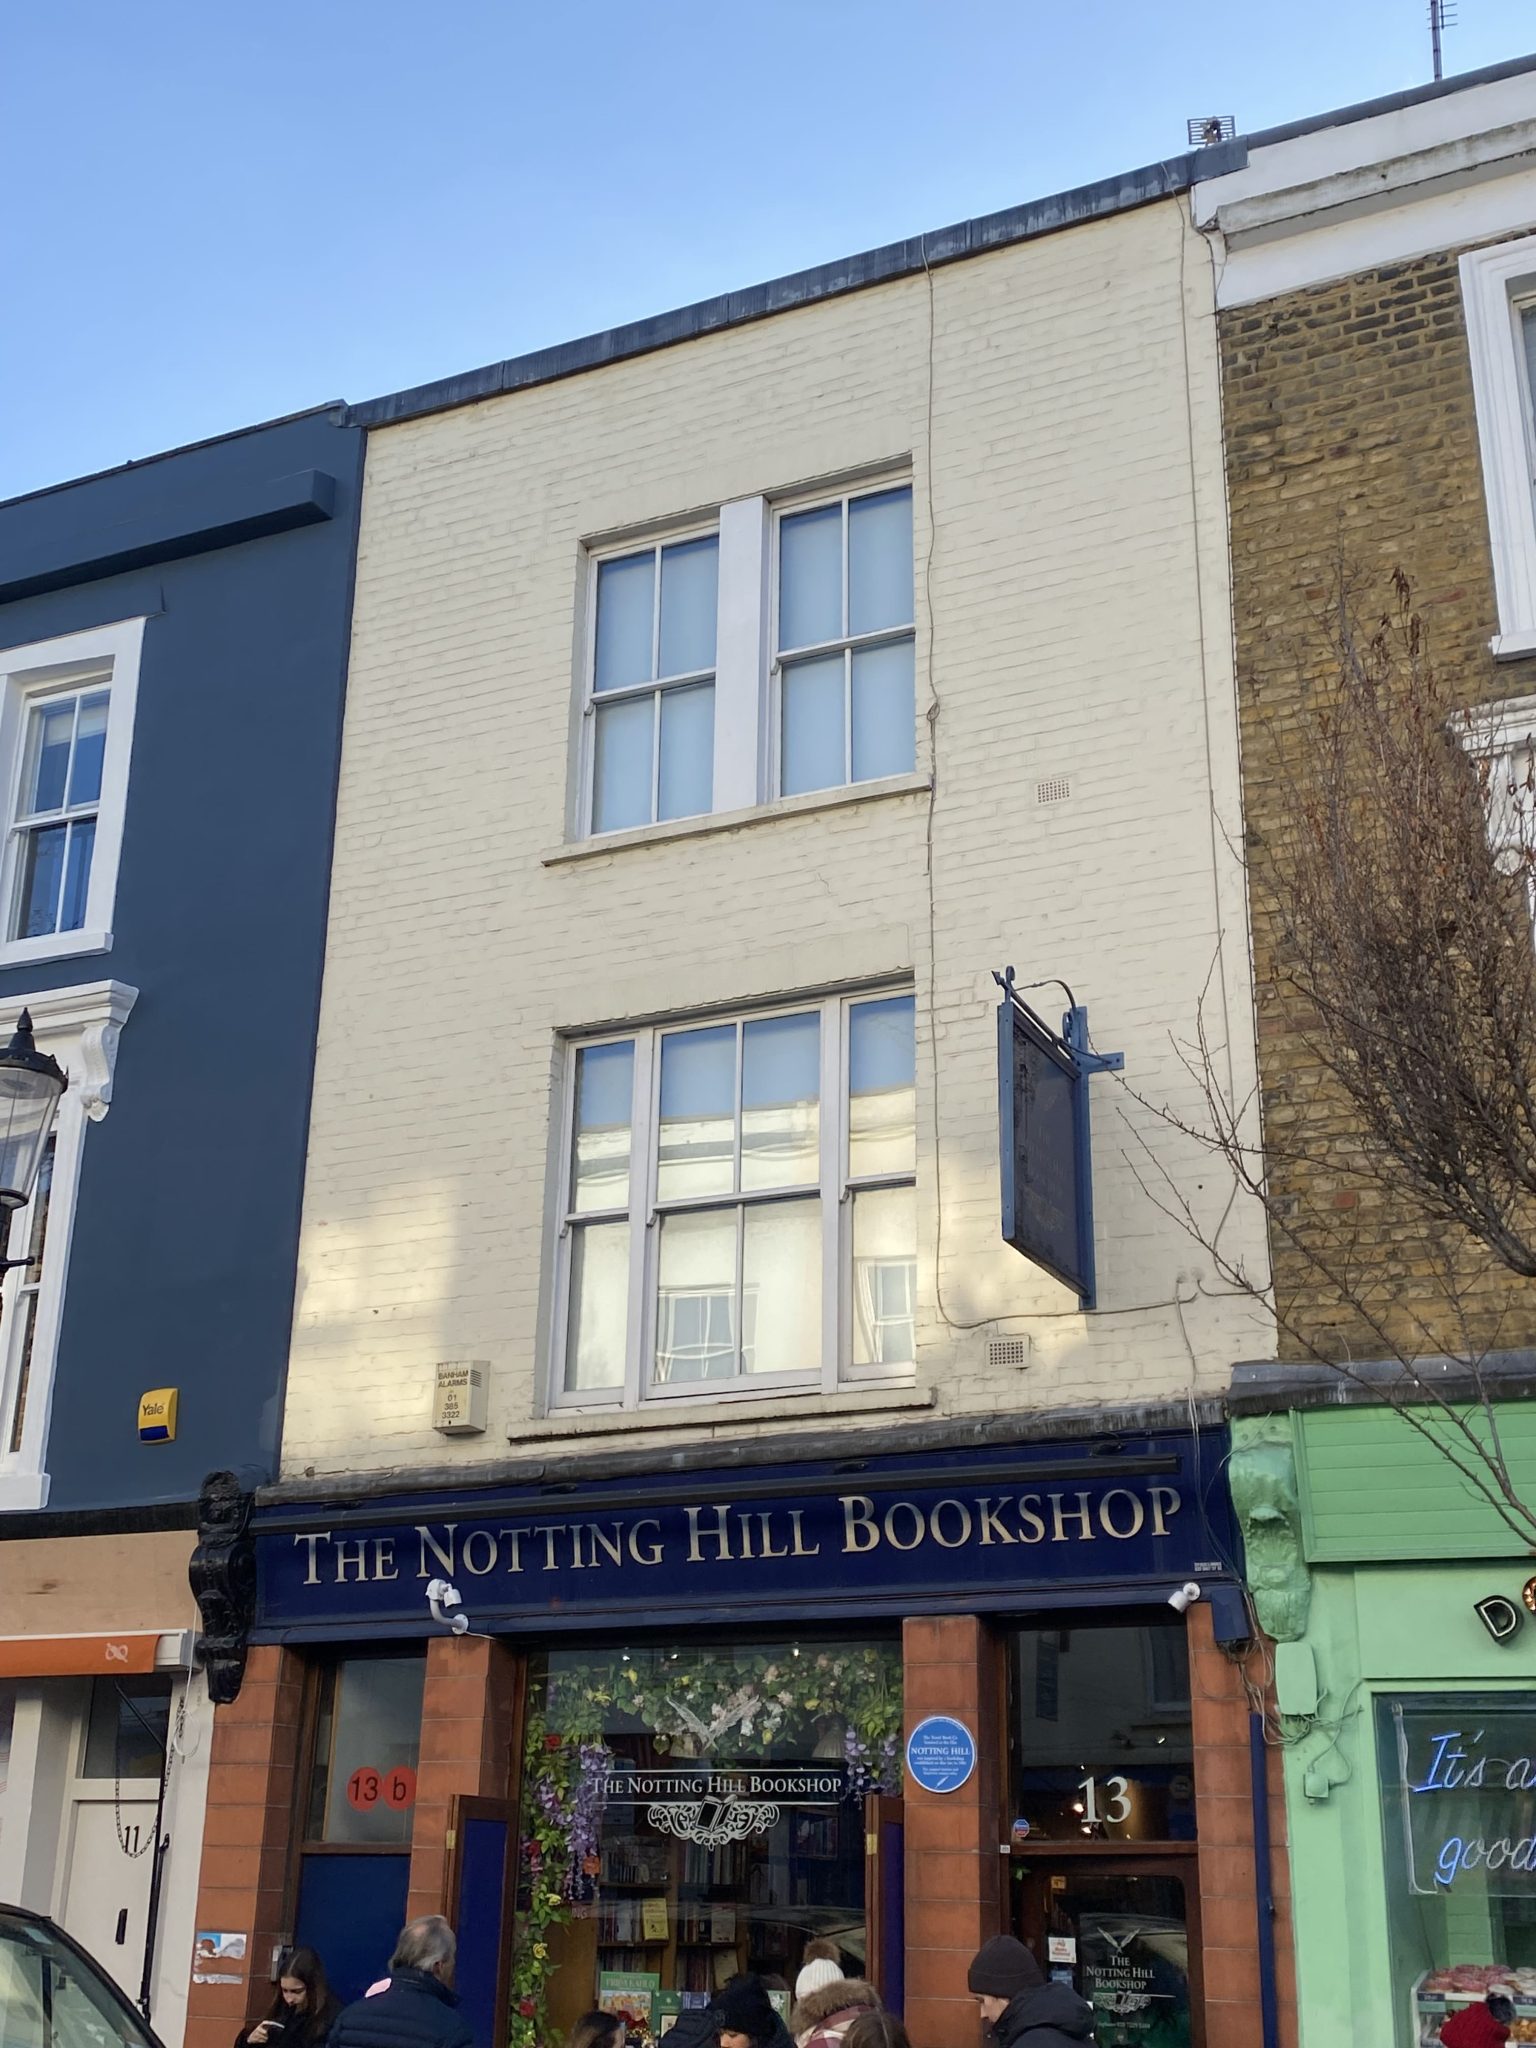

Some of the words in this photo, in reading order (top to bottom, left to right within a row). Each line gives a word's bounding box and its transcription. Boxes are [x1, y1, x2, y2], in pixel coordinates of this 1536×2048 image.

[438, 1370, 469, 1380] BANHAM
[438, 1379, 468, 1388] ALARMS
[142, 1403, 164, 1416] Yale
[441, 1411, 460, 1419] 3322
[294, 1531, 399, 1585] THE
[414, 1519, 665, 1578] NOTTING
[683, 1504, 821, 1562] HILL
[838, 1486, 1182, 1553] BOOKSHOP
[911, 1747, 950, 1755] NOTTING
[951, 1747, 971, 1755] HILL
[1413, 1729, 1487, 1793] It's
[627, 1777, 703, 1794] NOTTING
[707, 1776, 747, 1793] HILL
[749, 1776, 842, 1793] BOOKSHOP
[1078, 1776, 1132, 1823] 13
[124, 1825, 140, 1853] 11
[1434, 1837, 1536, 1884] good
[1086, 1966, 1130, 1977] NOTTING
[1132, 1967, 1156, 1979] HILL
[1095, 1978, 1147, 1990] BOOKSHOP
